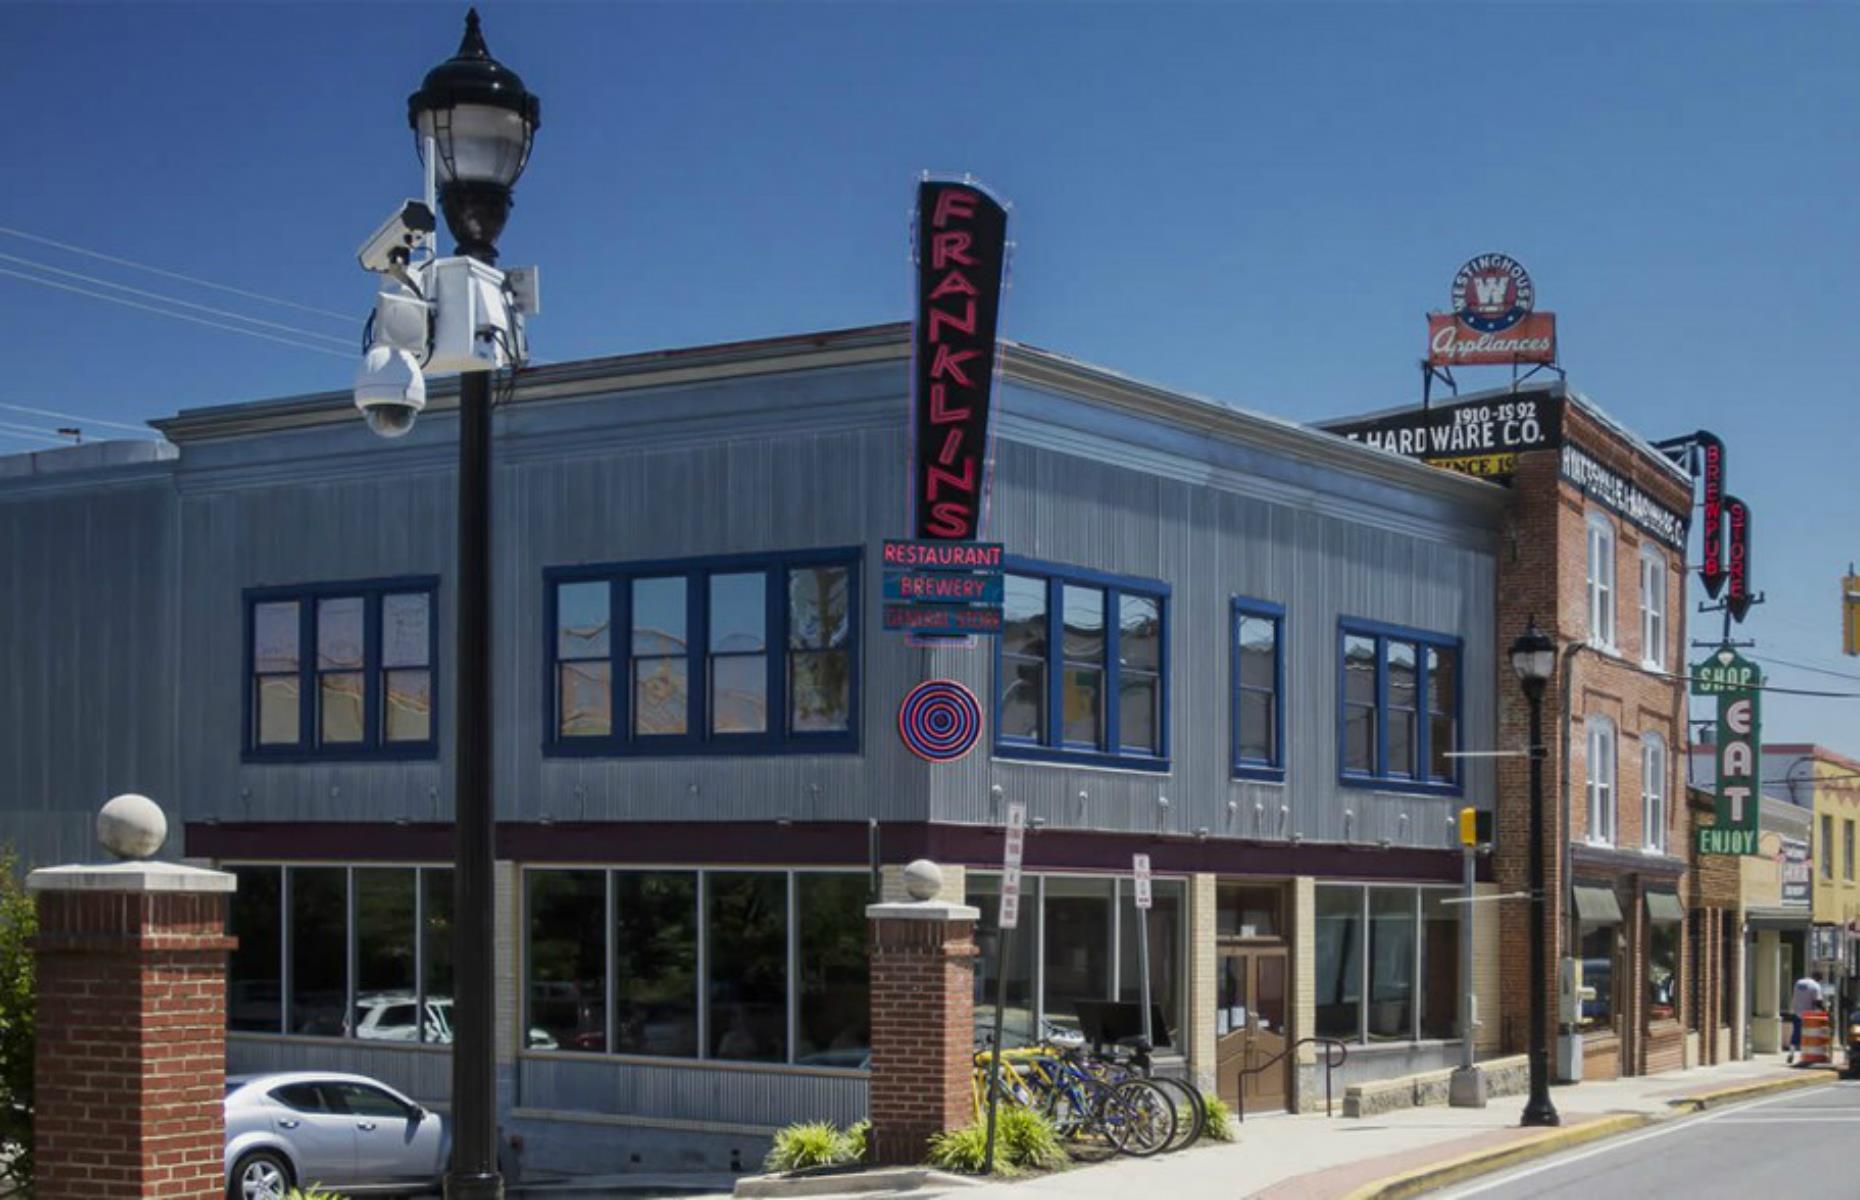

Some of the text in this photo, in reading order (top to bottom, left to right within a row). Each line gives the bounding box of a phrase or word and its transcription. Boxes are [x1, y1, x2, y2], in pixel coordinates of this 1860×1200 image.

[1453, 255, 1530, 312] WESTINGHOUSE
[1474, 276, 1510, 304] W
[1432, 325, 1550, 358] Appliances
[927, 187, 982, 538] FRANKLINS
[1367, 419, 1545, 456] HARDWARE CO.
[1705, 445, 1720, 576] BREWPUB
[884, 544, 1002, 566] RESTAURANT
[1730, 503, 1745, 597] STORE
[901, 575, 985, 597] BREWERY
[1700, 667, 1751, 691] SHOP
[1724, 699, 1752, 821] EAT
[1701, 829, 1756, 854] ENJOY
